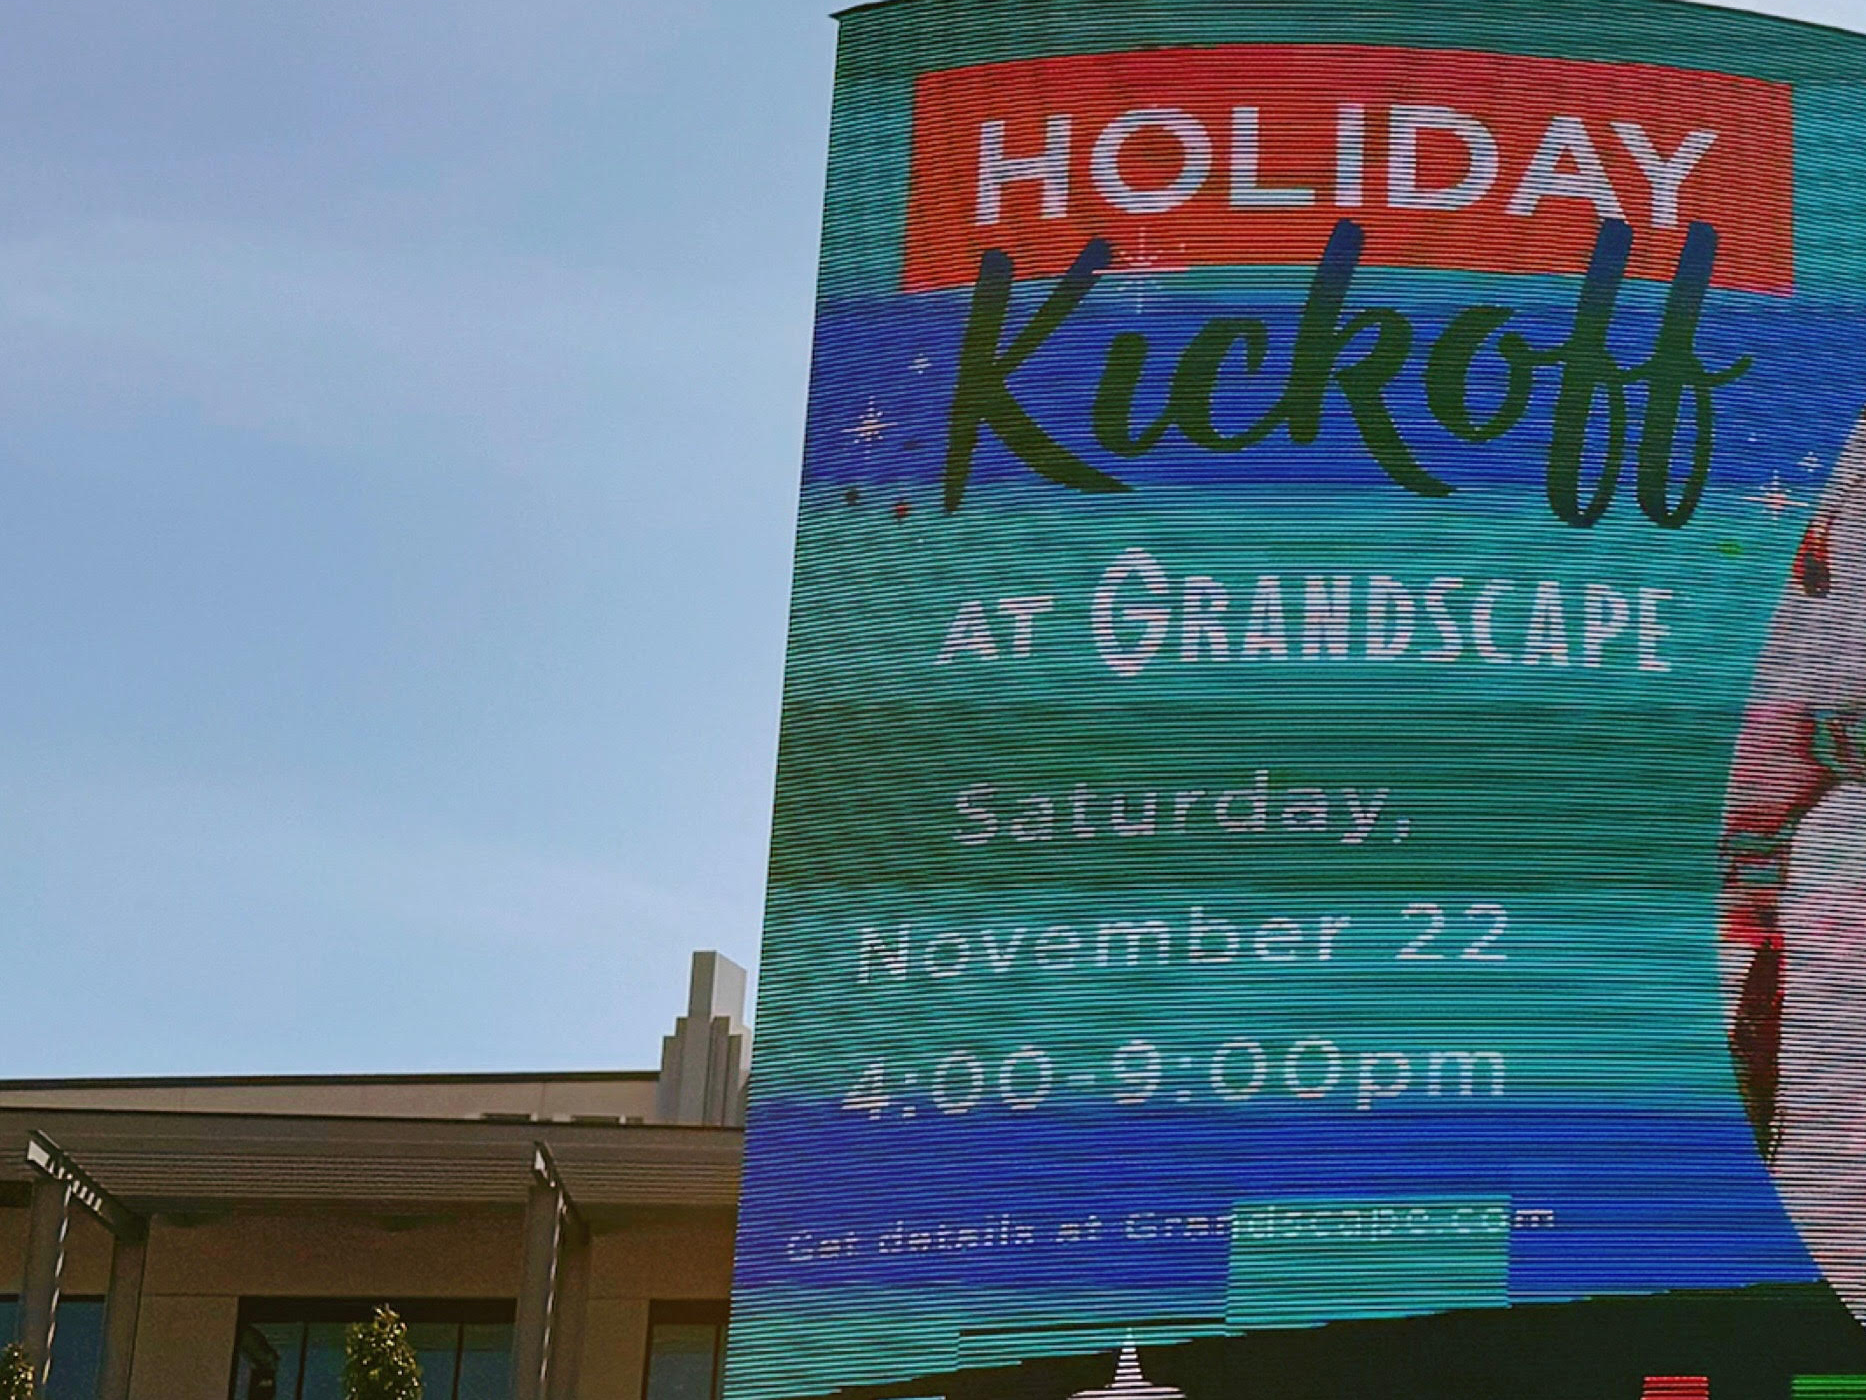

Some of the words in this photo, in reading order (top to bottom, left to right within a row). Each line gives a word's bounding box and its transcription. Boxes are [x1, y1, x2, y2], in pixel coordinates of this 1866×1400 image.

[973, 103, 1718, 229] HOLIDAY
[943, 218, 1753, 529] Kickoff
[1091, 547, 1675, 678] GRANDSCAPE
[952, 769, 1414, 846] Saturday,
[859, 905, 1351, 984] November
[1396, 901, 1509, 961] 22
[841, 1035, 1506, 1121] 4:00-9:00pm
[785, 1229, 860, 1263] Get
[878, 1212, 1036, 1254] details
[1055, 1214, 1102, 1244] at
[1124, 1205, 1555, 1243] Grandscape.com
